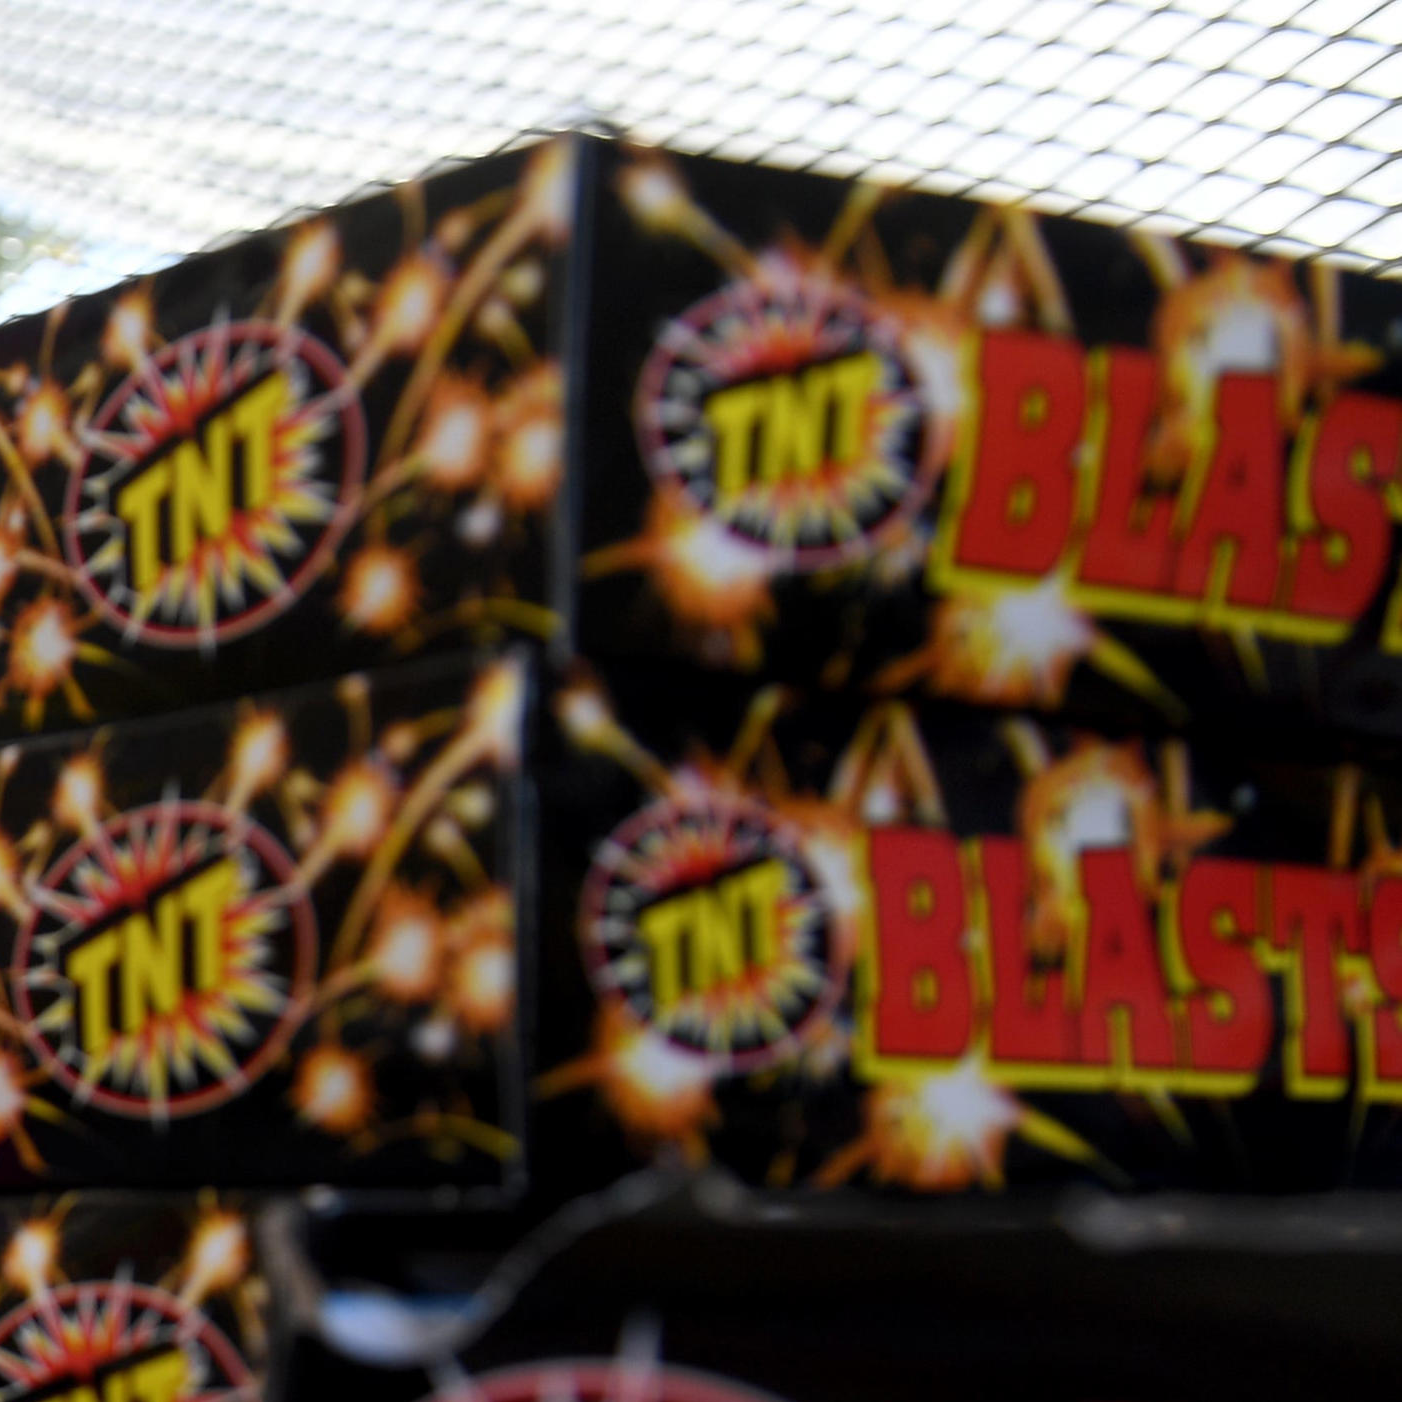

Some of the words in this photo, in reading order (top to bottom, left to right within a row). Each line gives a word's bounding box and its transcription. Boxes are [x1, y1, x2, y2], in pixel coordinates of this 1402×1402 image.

[117, 371, 293, 598] TNT
[704, 351, 880, 498] TNT
[927, 330, 1402, 643] BLAS
[67, 854, 239, 1058] TNT
[641, 861, 787, 1004] TNT
